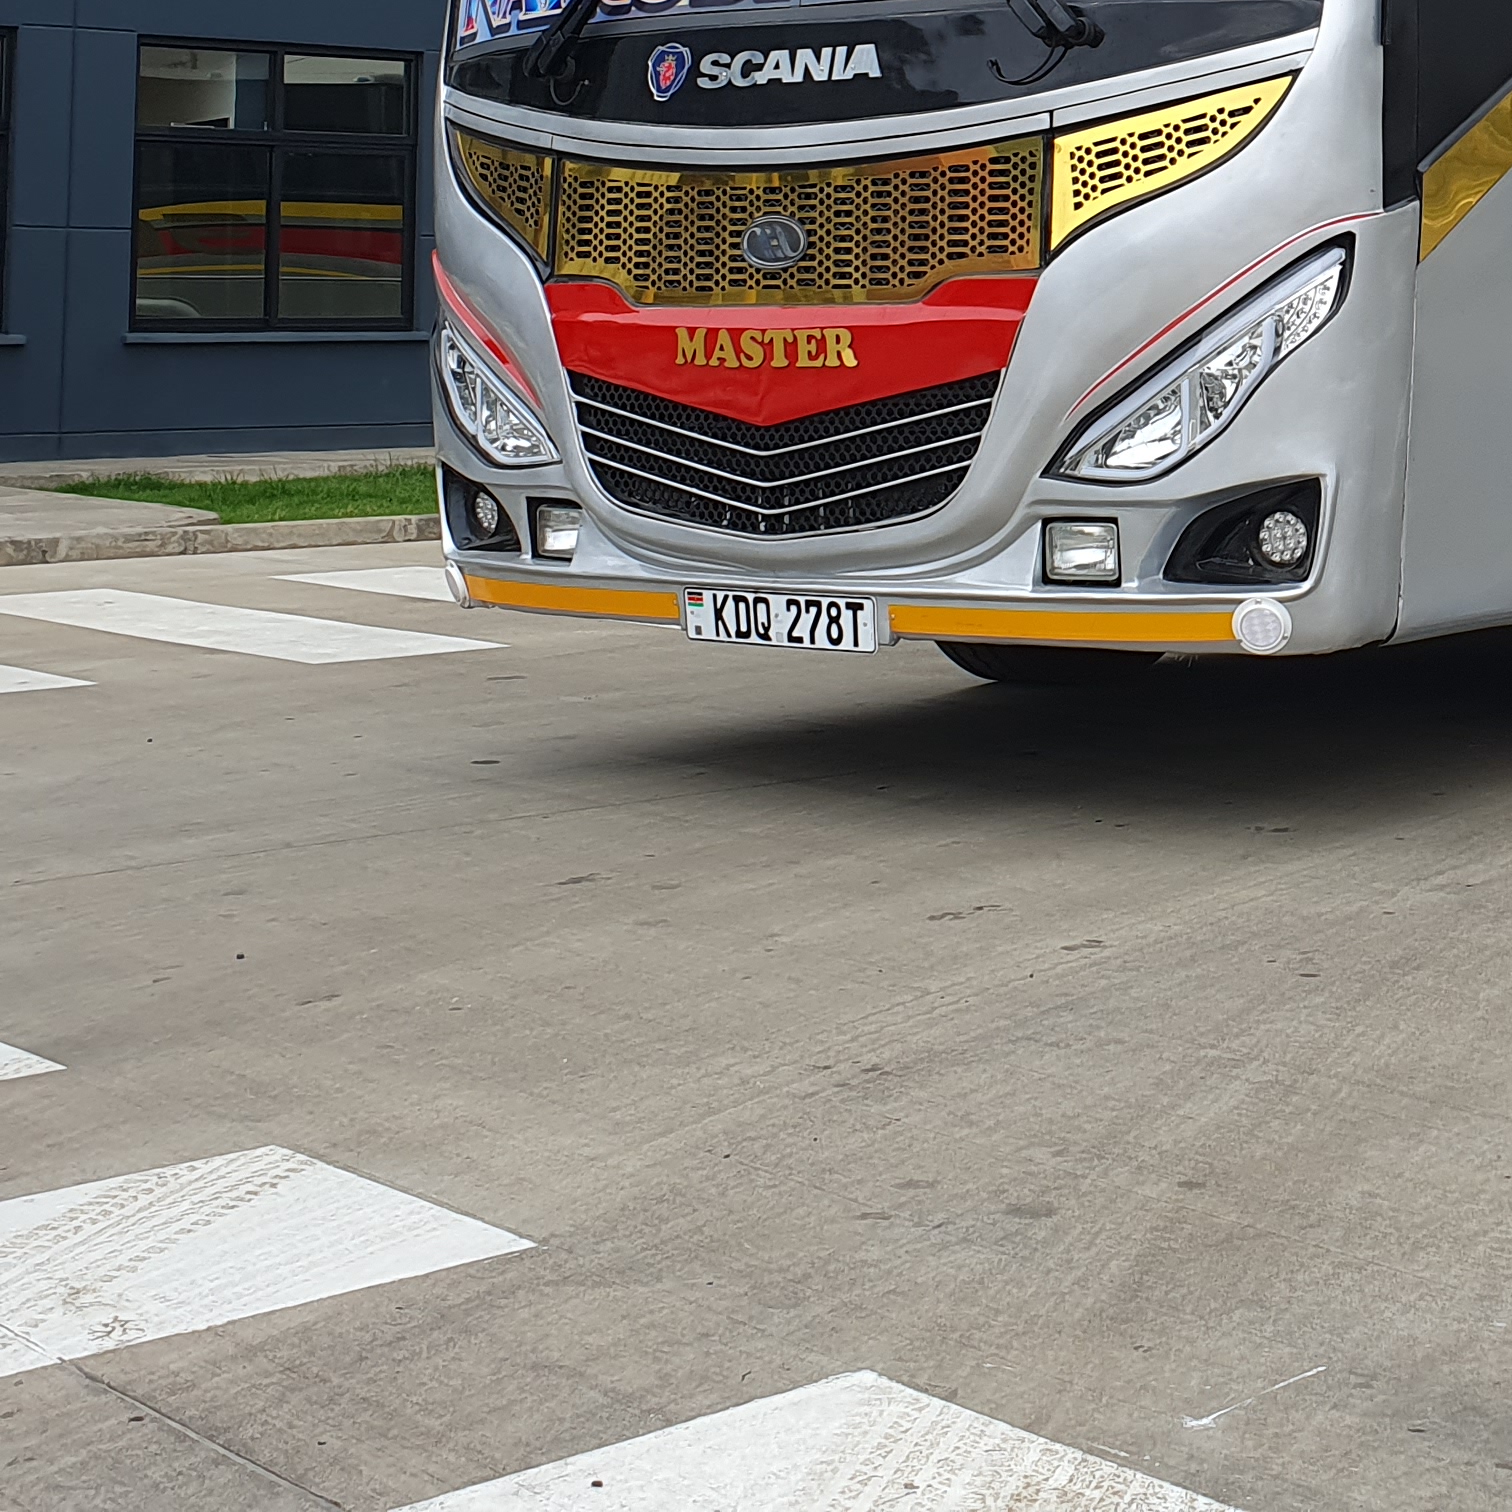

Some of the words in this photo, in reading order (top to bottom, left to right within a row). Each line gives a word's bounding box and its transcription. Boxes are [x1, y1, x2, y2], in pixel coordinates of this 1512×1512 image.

[696, 43, 883, 89] SCANIA
[674, 326, 859, 369] MASTER
[711, 592, 773, 642] KDQ
[785, 597, 866, 649] 278T
